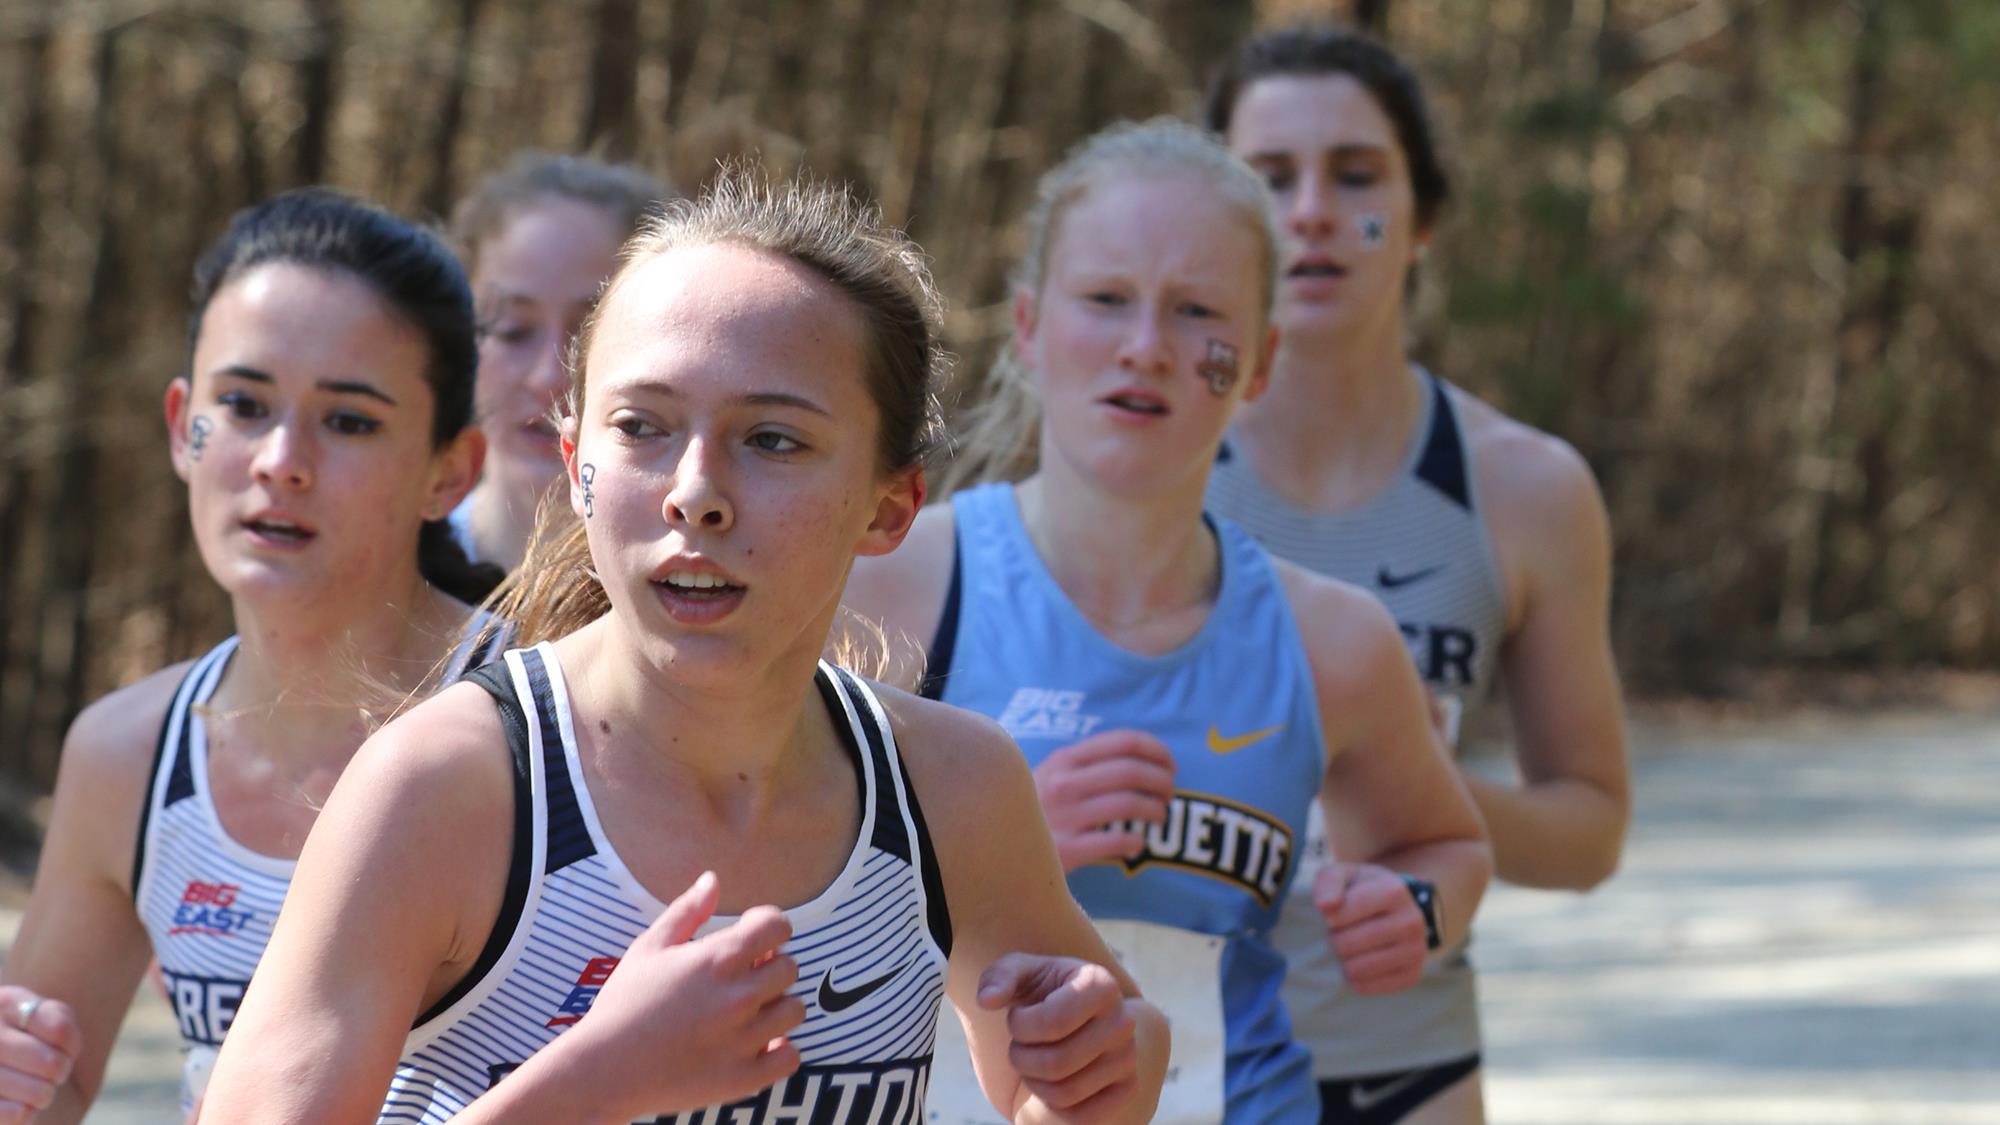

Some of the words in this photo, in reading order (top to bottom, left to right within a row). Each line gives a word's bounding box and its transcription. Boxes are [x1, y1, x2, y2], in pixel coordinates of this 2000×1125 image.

[1112, 796, 1289, 899] UETTE
[182, 881, 241, 906] BIG
[173, 904, 253, 933] EAST
